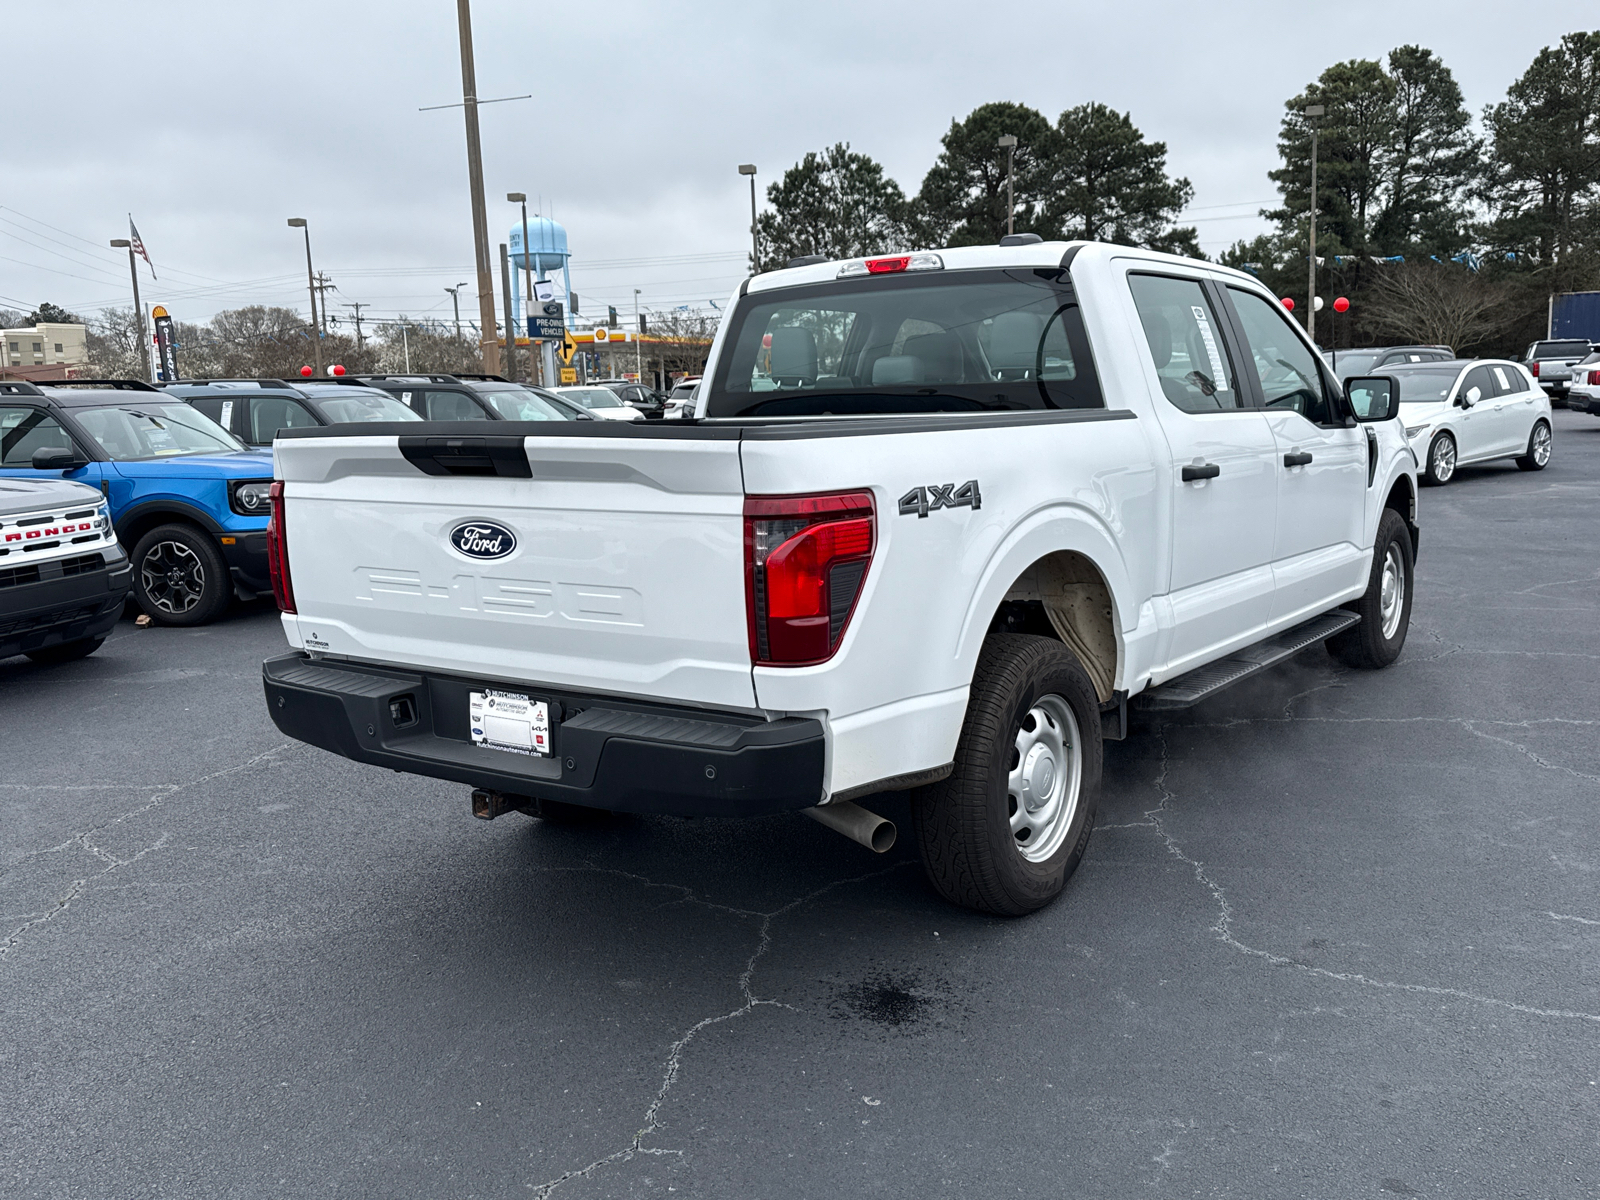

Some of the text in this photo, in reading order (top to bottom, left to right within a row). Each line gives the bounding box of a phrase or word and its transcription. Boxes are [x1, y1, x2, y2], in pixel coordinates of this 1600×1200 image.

[536, 319, 564, 327] PRE-OWNE
[540, 328, 564, 336] VEHICLES
[163, 327, 177, 381] OIL CHANGE
[460, 526, 502, 553] Ford
[353, 565, 645, 627] F-150
[492, 690, 529, 701] HUTCHINSON
[496, 701, 528, 711] HUTCHINSON
